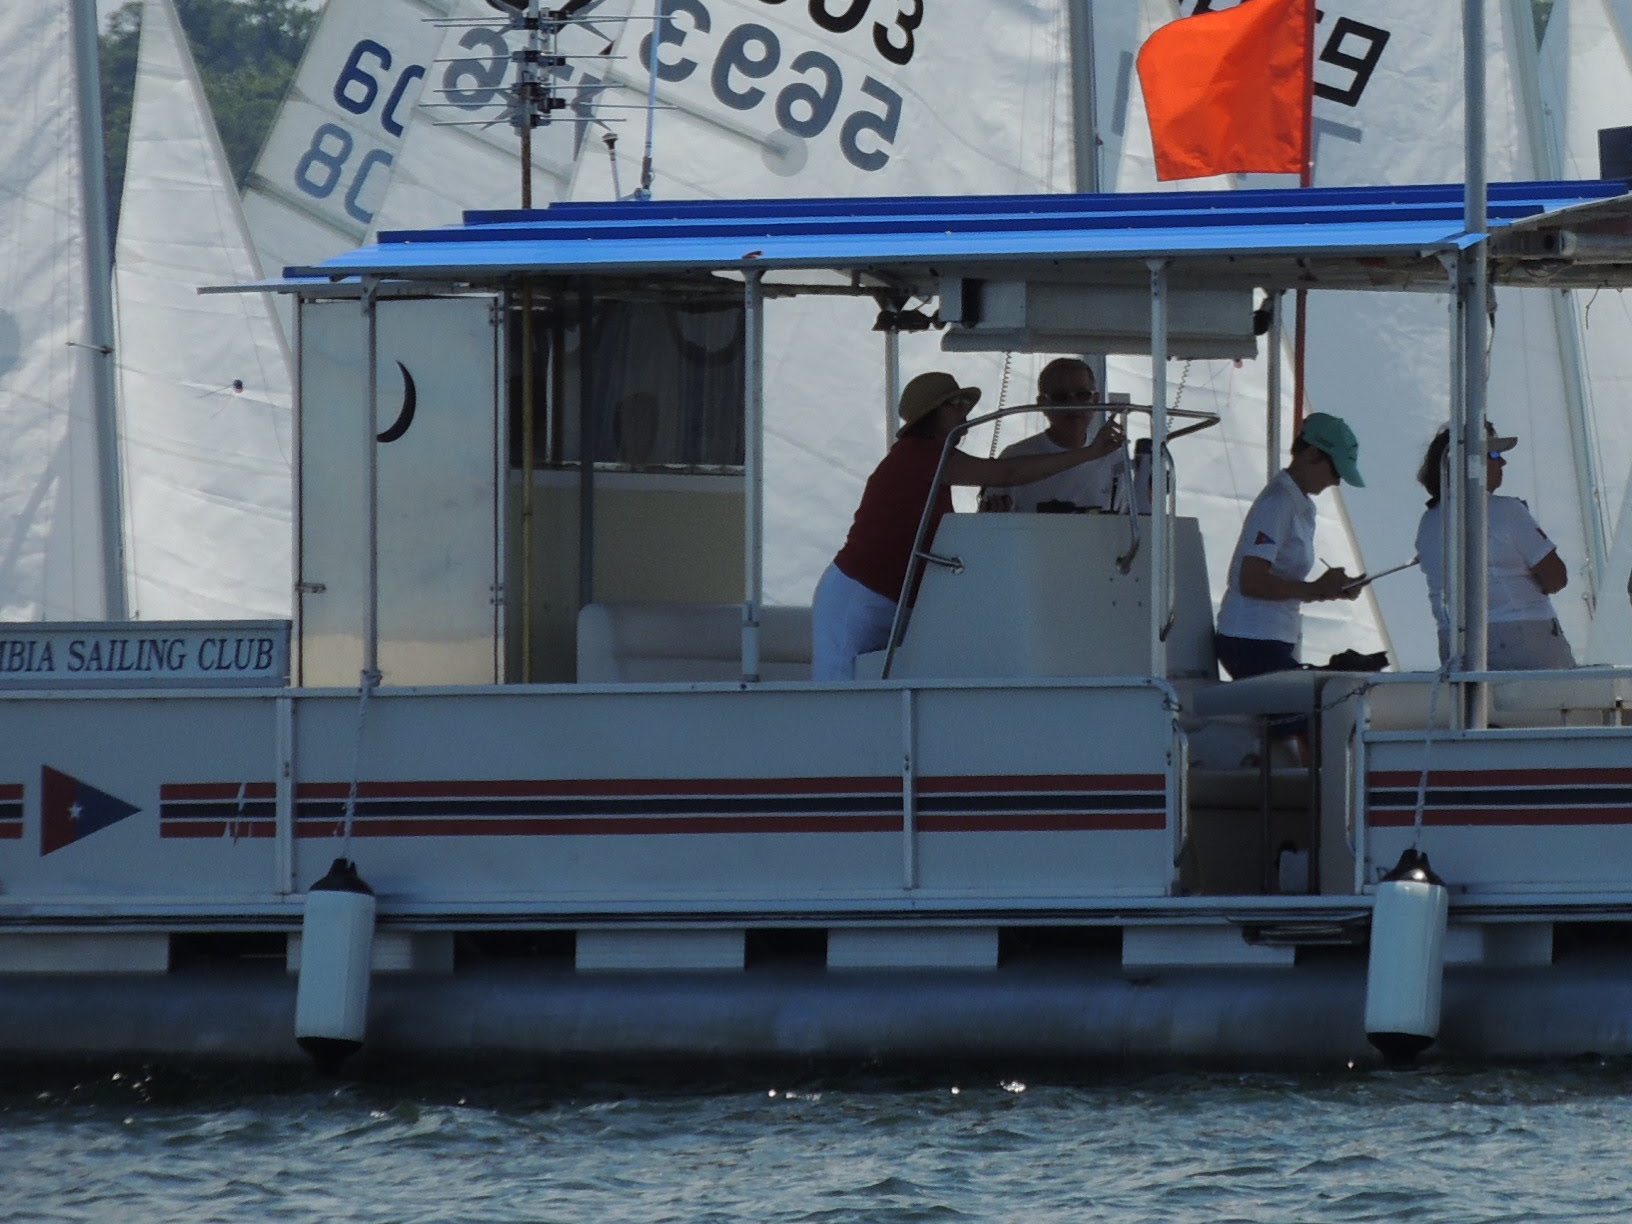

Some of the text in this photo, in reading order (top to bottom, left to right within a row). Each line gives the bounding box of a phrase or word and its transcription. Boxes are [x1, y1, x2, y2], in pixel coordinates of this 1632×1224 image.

[0, 638, 275, 673] BIA SAILING CLUB
